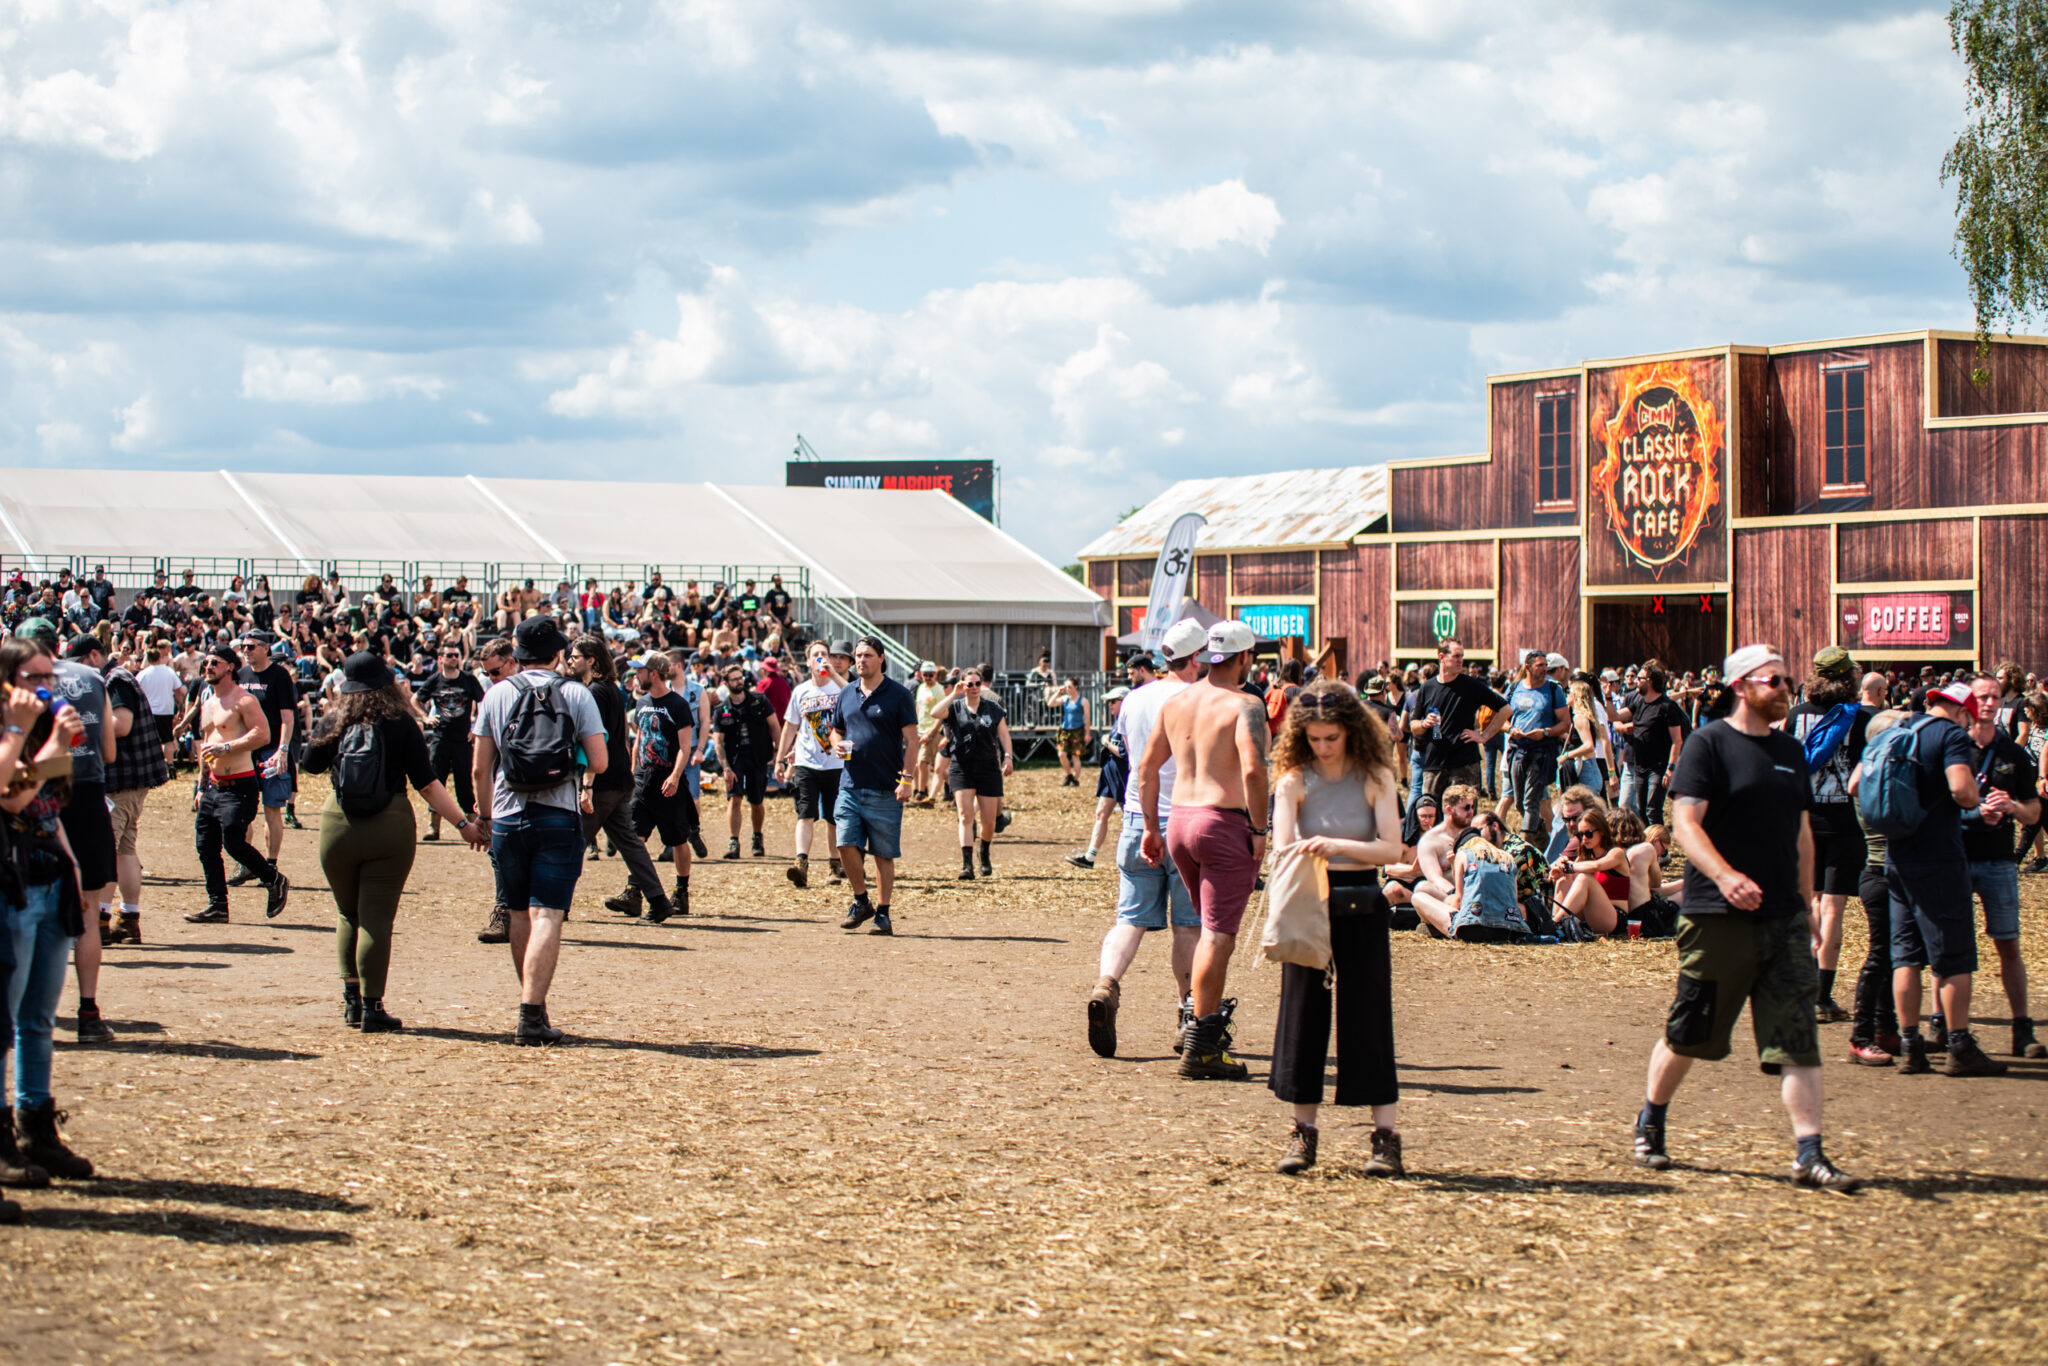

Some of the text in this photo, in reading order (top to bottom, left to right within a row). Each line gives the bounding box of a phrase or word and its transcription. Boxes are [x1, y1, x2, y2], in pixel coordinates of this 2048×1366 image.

[1622, 433, 1689, 462] CLASSIC
[1622, 463, 1692, 508] ROCK
[1633, 509, 1680, 538] CAFE
[1870, 606, 1943, 632] COFFEE
